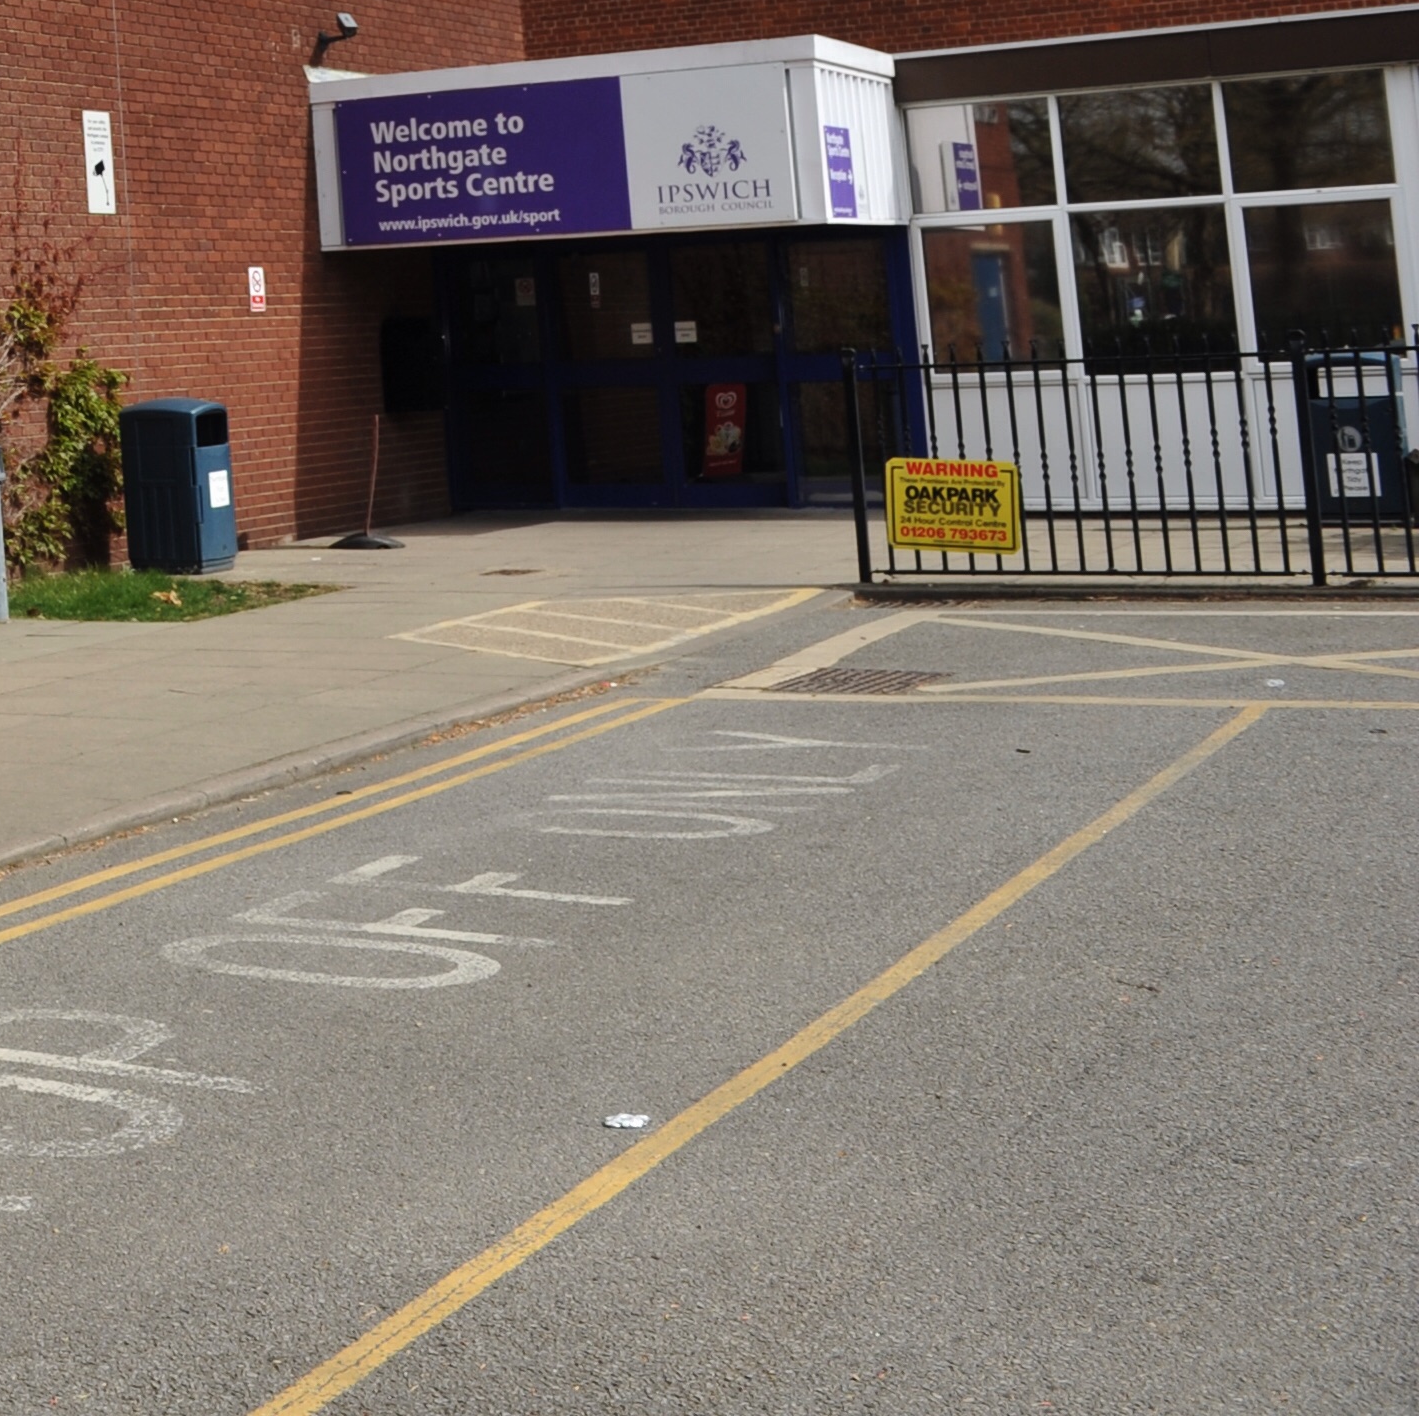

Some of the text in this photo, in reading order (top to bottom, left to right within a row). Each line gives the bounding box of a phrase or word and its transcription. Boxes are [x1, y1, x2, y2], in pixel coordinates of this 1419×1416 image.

[370, 112, 524, 145] Welcome to
[373, 144, 507, 175] Northgate
[375, 171, 555, 208] Sports Centre
[657, 178, 773, 204] IPSWICH
[658, 200, 774, 215] BOROUGH COUNCIL
[378, 208, 561, 232] www.ipswich.gov.uk/sport
[906, 461, 998, 478] WARNING
[905, 485, 999, 503] OAKPARK
[904, 500, 1001, 517] SECURITY
[900, 516, 1007, 528] 24 Hour Control Centre
[900, 526, 1007, 542] 01206 793673
[162, 854, 636, 989] OFF
